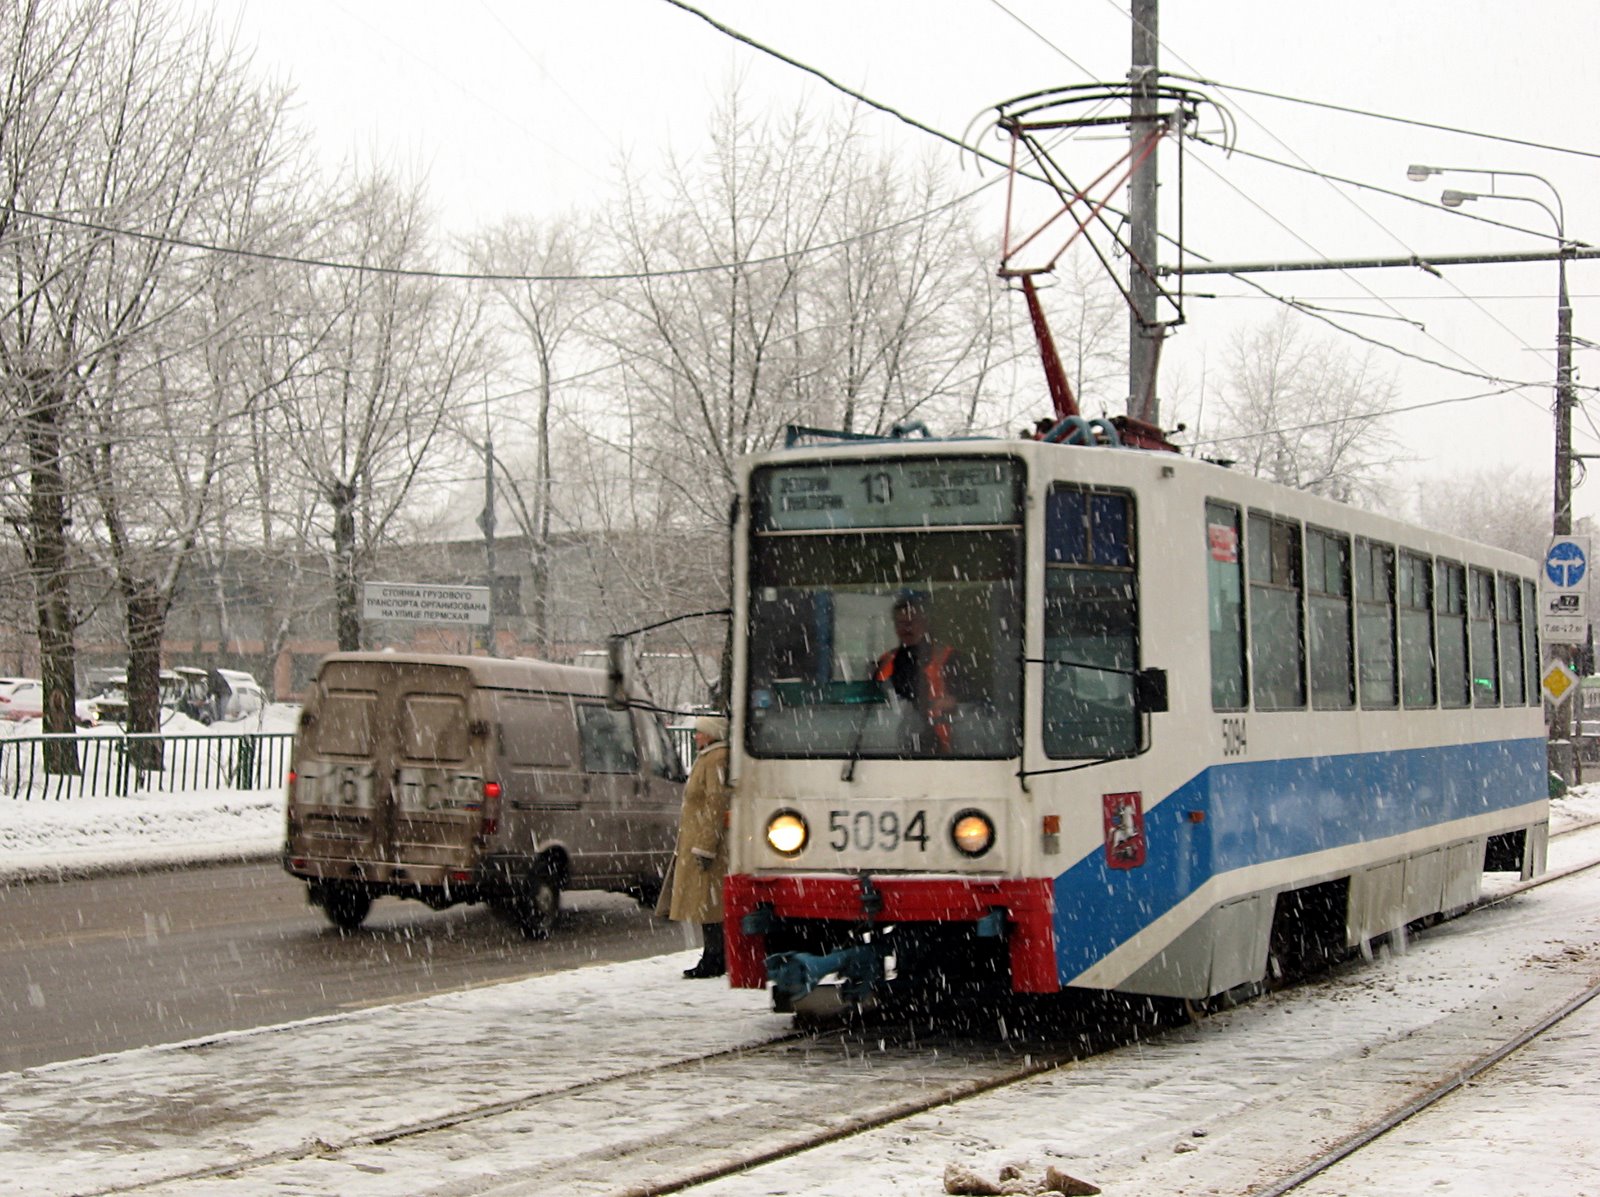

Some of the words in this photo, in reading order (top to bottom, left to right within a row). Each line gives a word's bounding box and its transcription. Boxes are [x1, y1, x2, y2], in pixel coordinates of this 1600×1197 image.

[861, 472, 893, 504] 13
[366, 597, 419, 608] ТРАНСПОРТА
[420, 600, 488, 611] ОРГАНИЗОВАНА
[382, 588, 421, 598] СТОЯНКА
[422, 590, 473, 600] ГРУЗОВОГО
[381, 609, 394, 617] НА
[395, 609, 422, 620] УЛИЦЕ
[423, 611, 470, 621] ПЕРМСКАЯ
[1222, 718, 1248, 757] 5094
[828, 809, 931, 852] 5094
